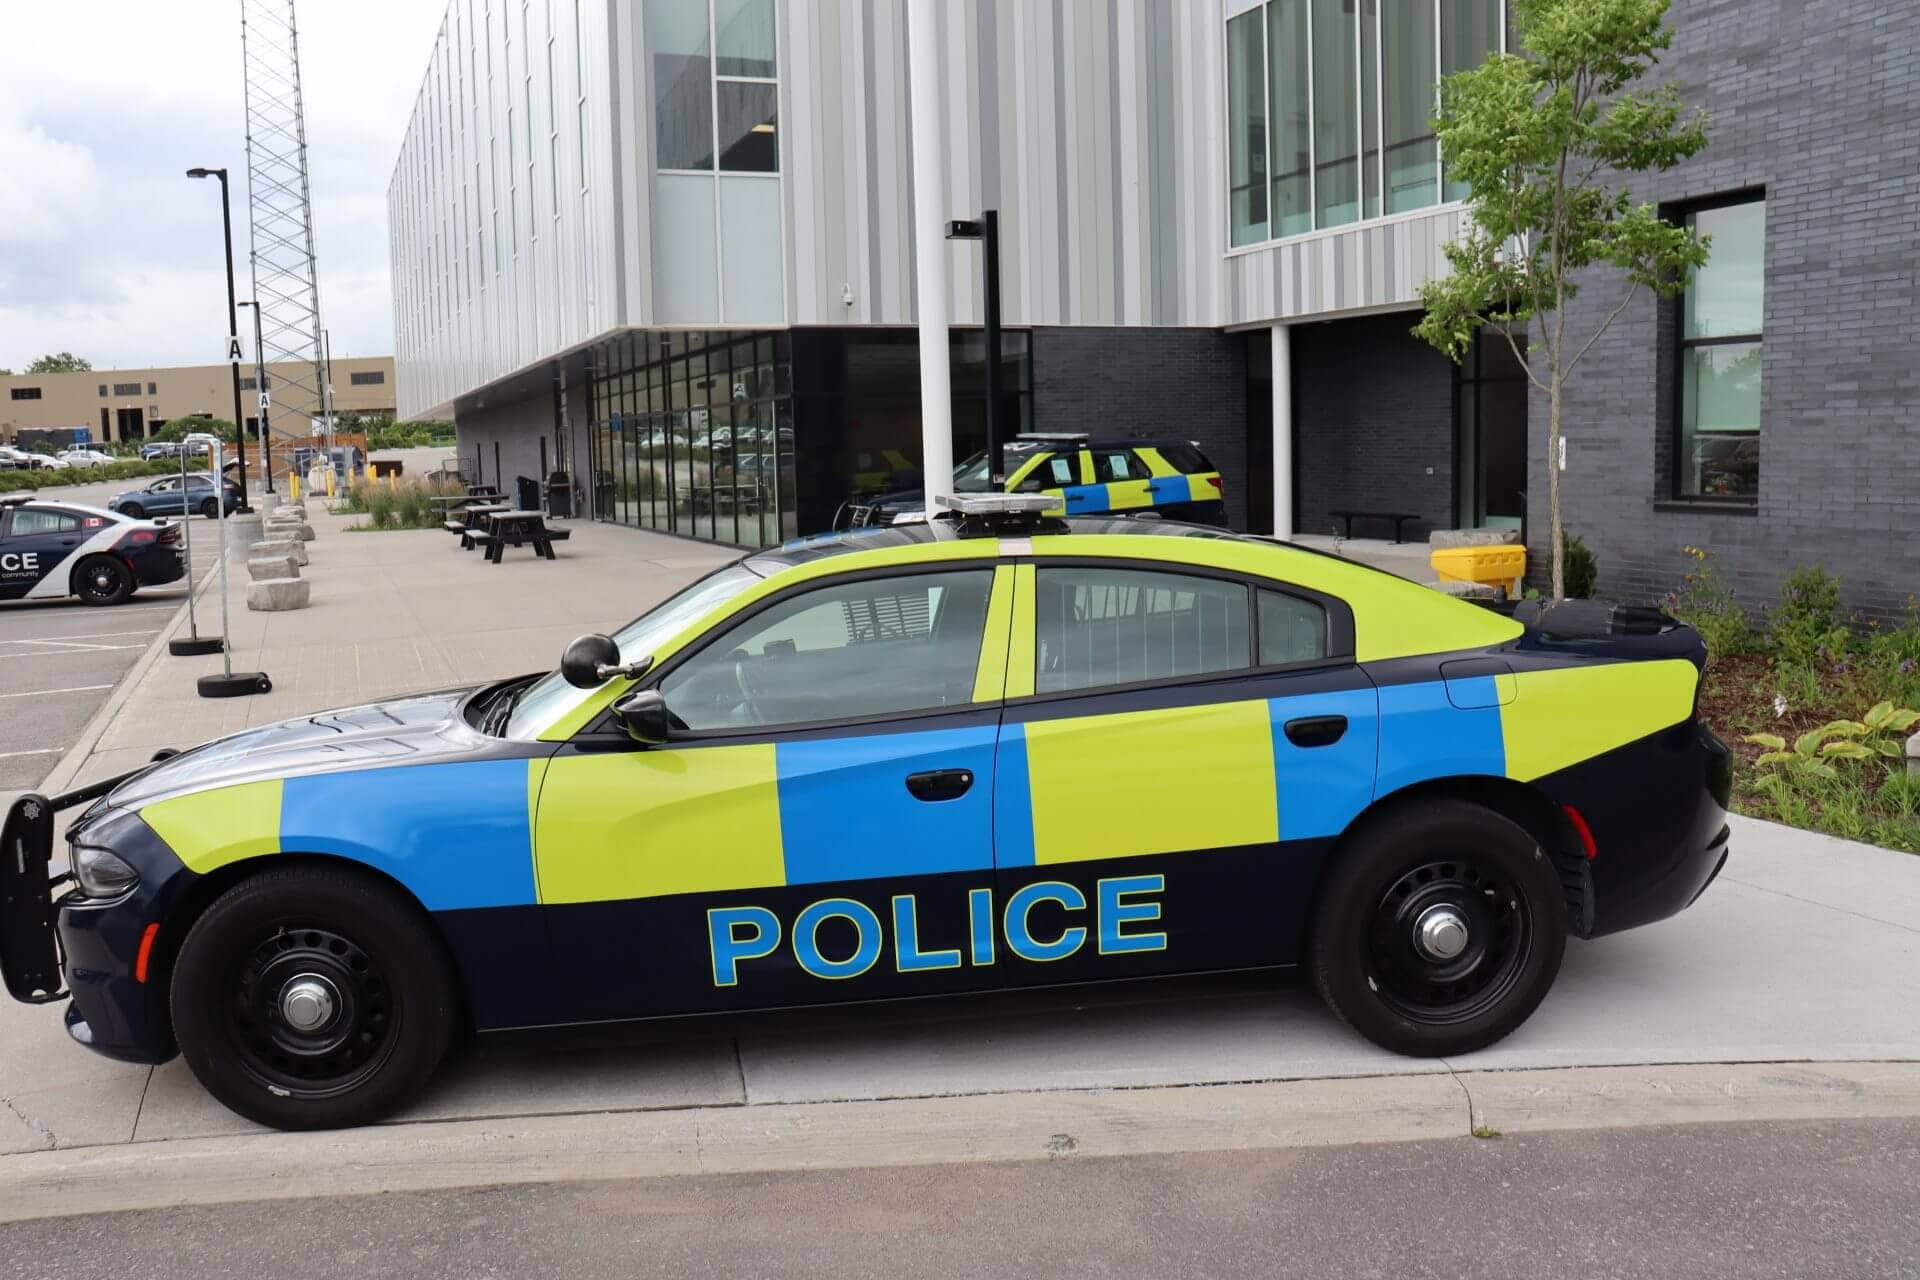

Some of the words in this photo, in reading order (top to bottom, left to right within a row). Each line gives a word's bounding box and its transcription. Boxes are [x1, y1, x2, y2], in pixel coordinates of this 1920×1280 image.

[229, 339, 242, 359] A
[260, 395, 269, 406] A
[707, 874, 1167, 986] POLICE
